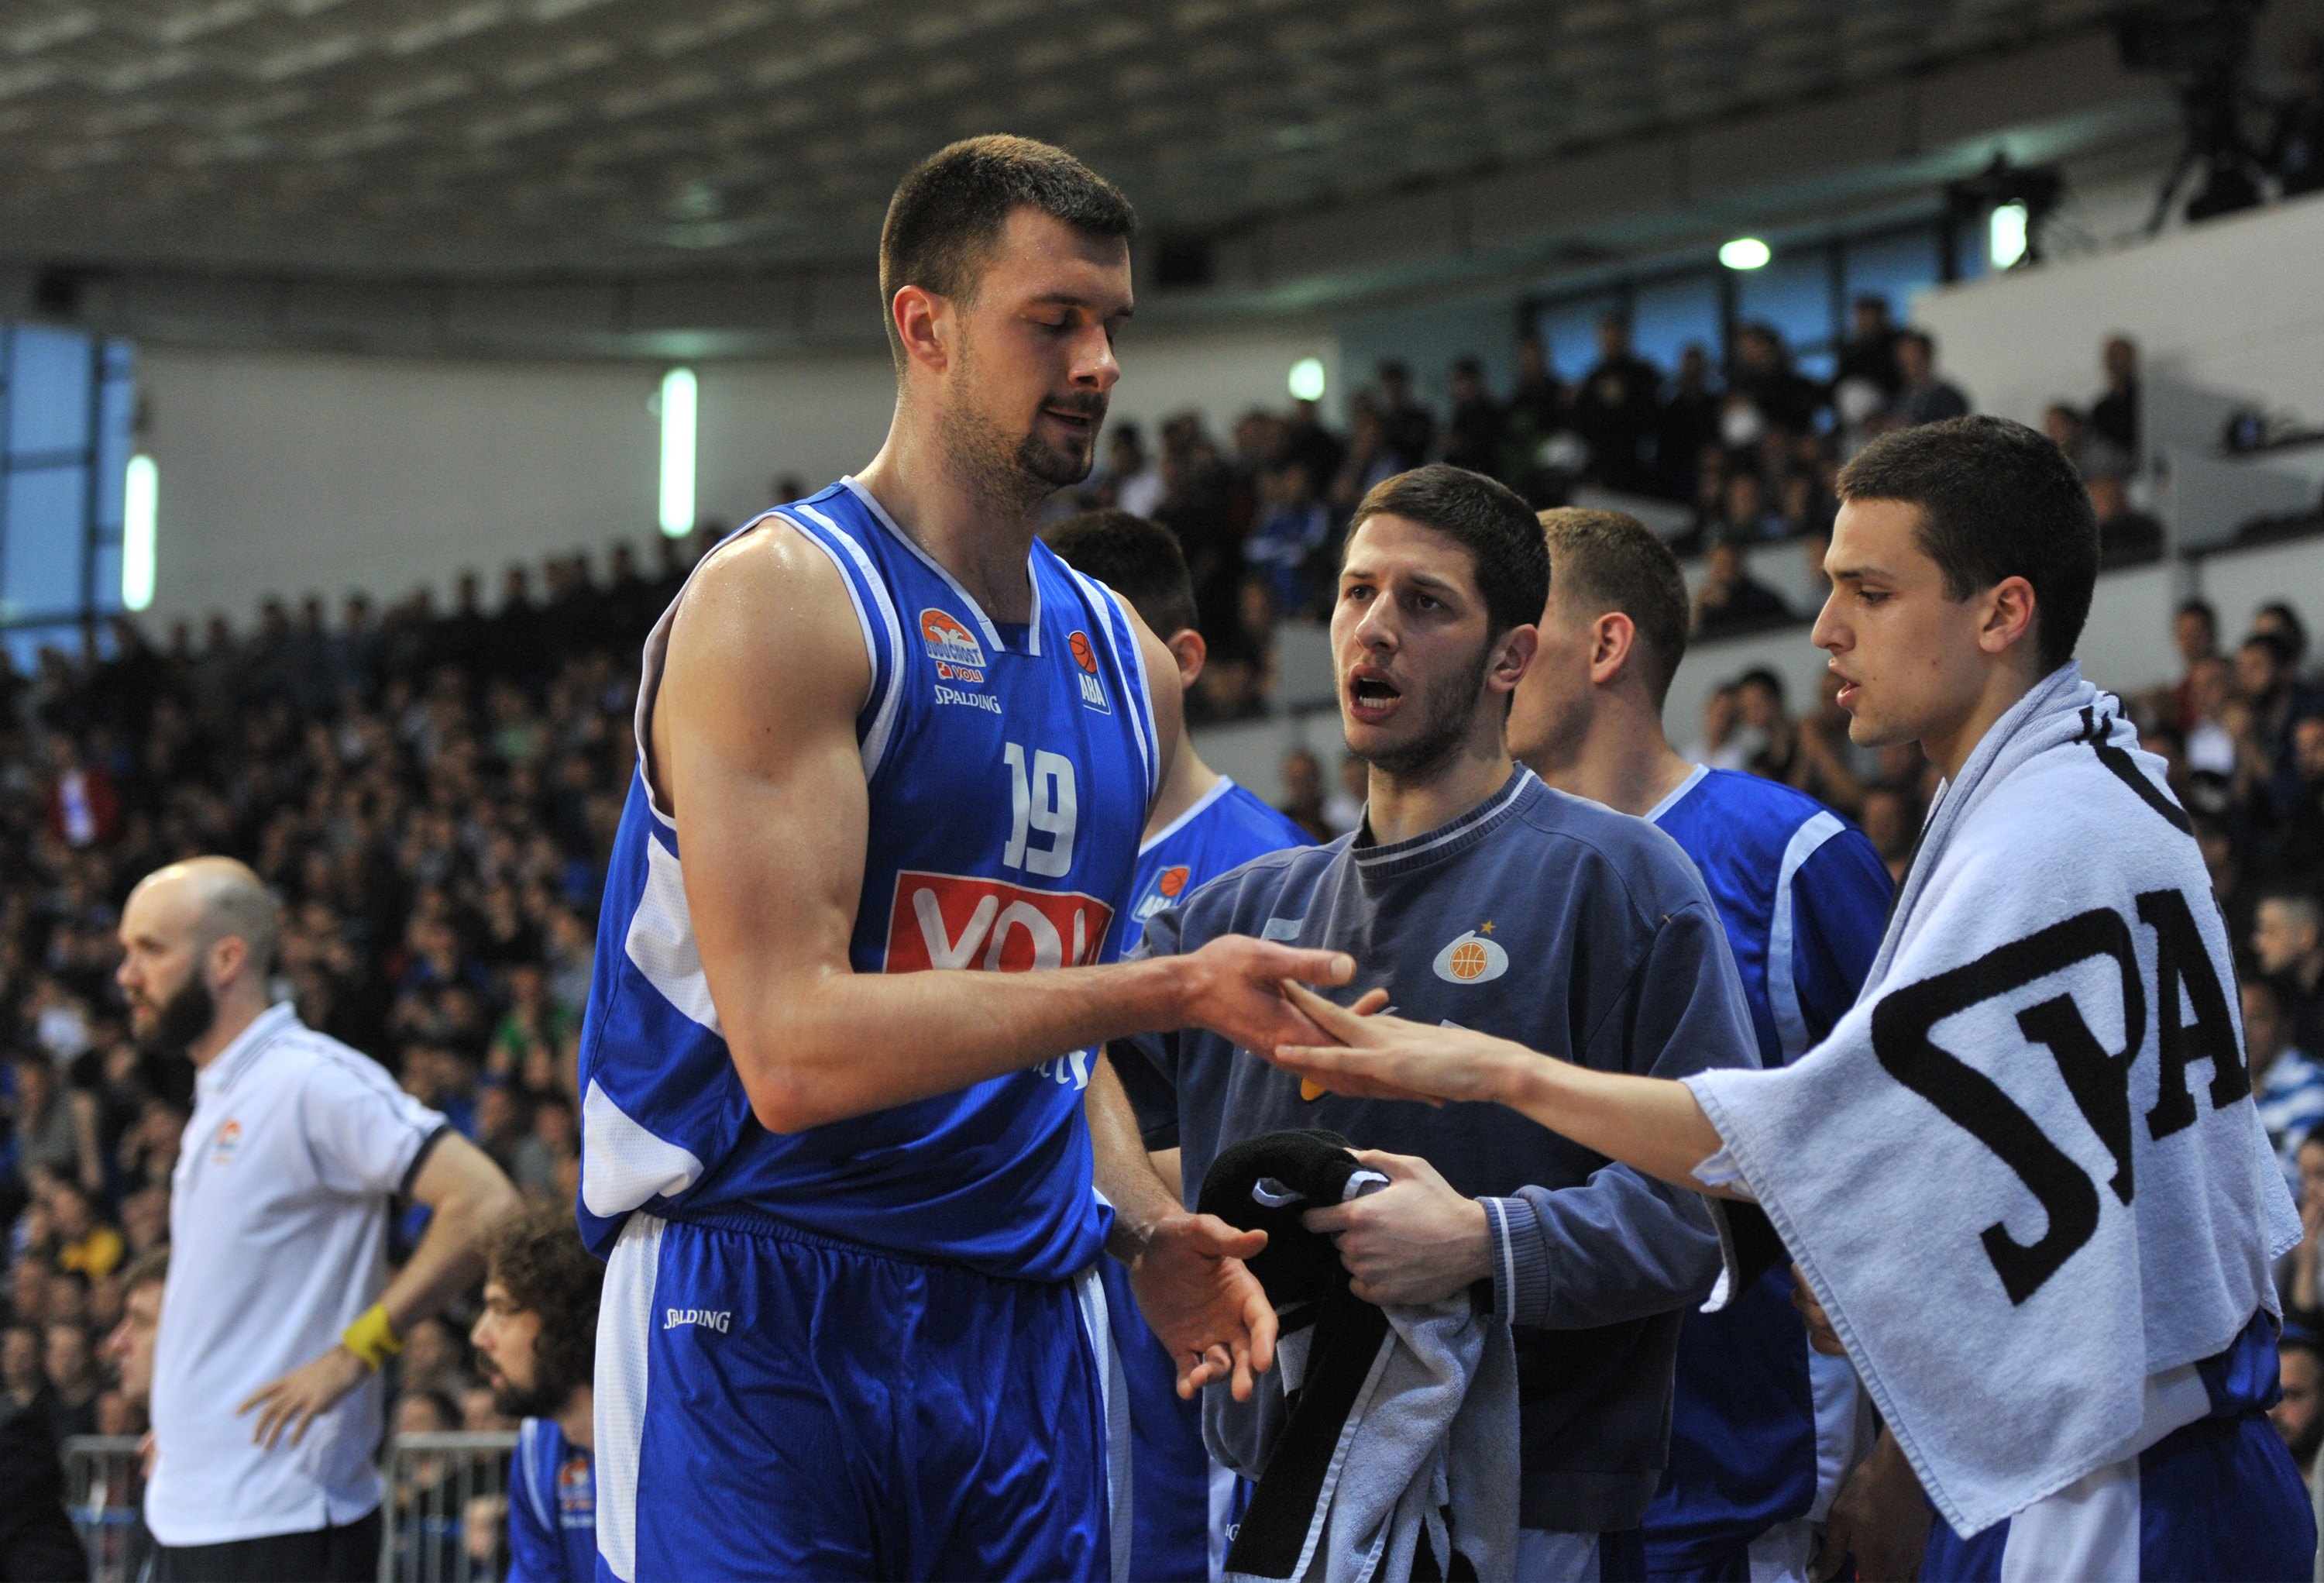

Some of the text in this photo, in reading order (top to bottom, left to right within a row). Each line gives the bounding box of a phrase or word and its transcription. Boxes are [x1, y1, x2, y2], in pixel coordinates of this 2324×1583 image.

[952, 665, 985, 683] VOLI
[1078, 673, 1107, 707] ABA
[934, 684, 1002, 714] SPALDING
[1003, 742, 1078, 878] 19
[1871, 887, 2251, 1306] SPA
